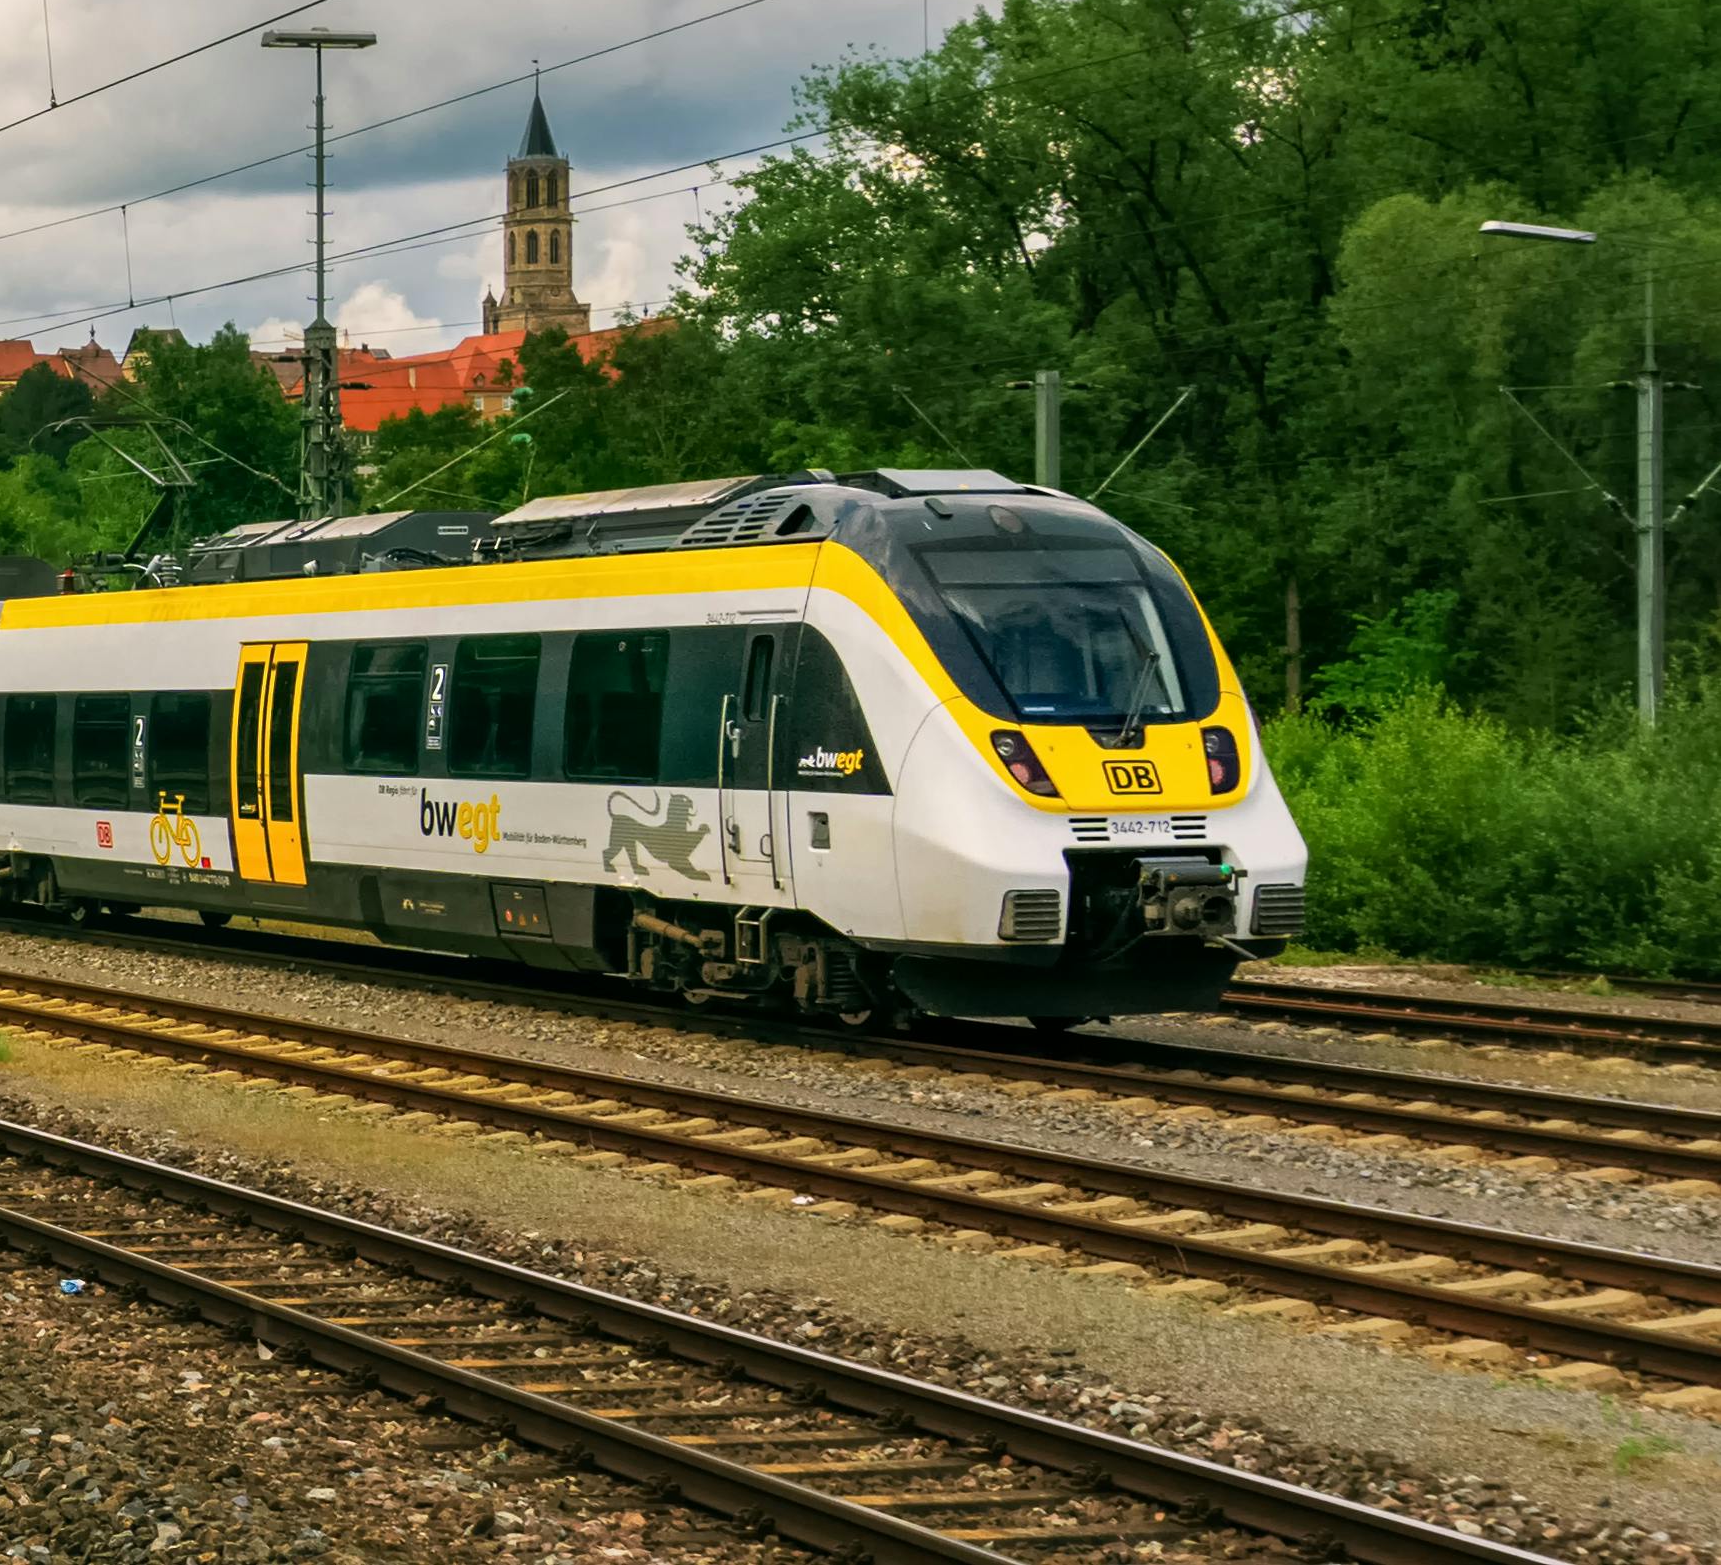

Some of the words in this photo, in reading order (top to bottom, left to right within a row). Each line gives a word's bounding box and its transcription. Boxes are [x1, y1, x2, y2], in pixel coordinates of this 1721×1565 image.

[431, 667, 445, 701] 2
[135, 718, 143, 746] 2
[816, 746, 864, 775] bwegt
[1110, 766, 1155, 789] DB
[420, 787, 501, 853] bwegt
[1111, 821, 1171, 834] 3442-712
